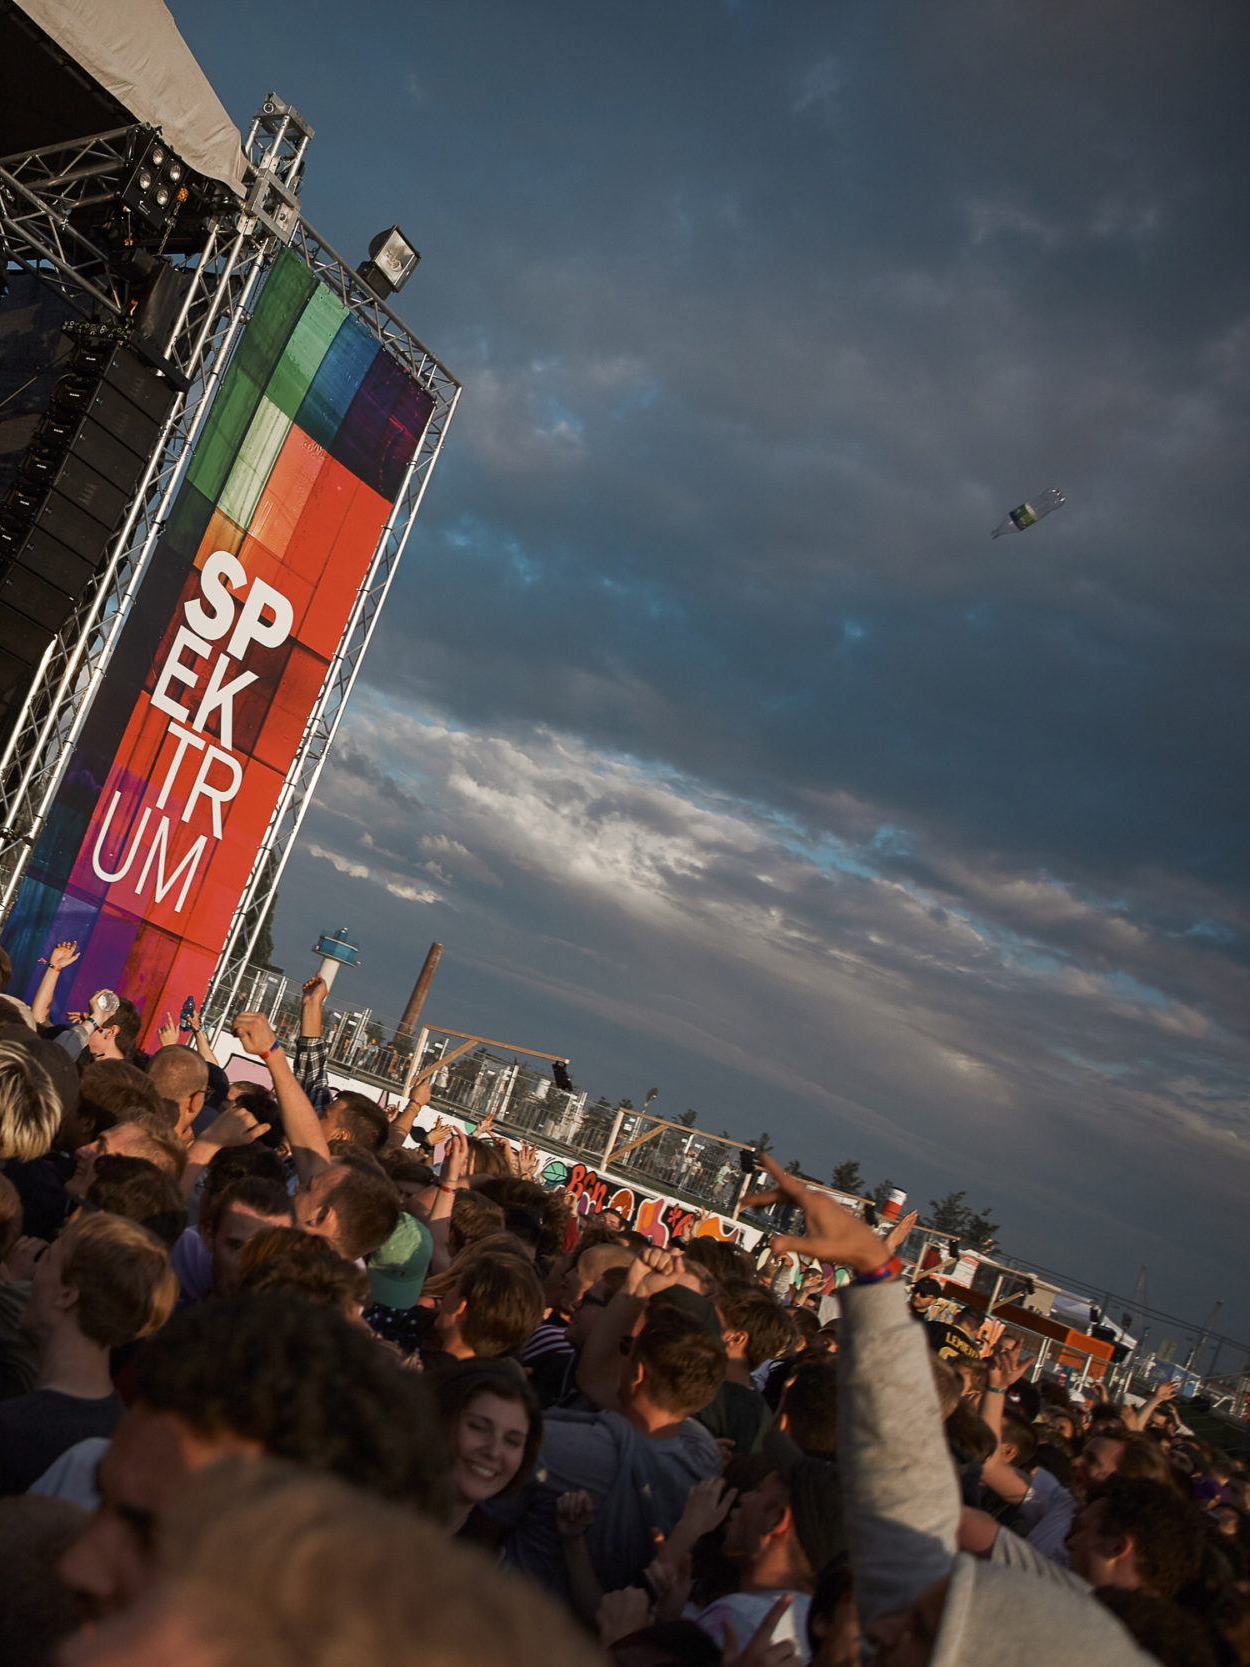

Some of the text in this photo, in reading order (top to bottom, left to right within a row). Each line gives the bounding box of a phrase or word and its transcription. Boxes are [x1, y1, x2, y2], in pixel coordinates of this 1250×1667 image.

[183, 550, 294, 661] SP
[150, 625, 259, 751] EK
[156, 721, 243, 840] TR
[92, 790, 208, 913] UM
